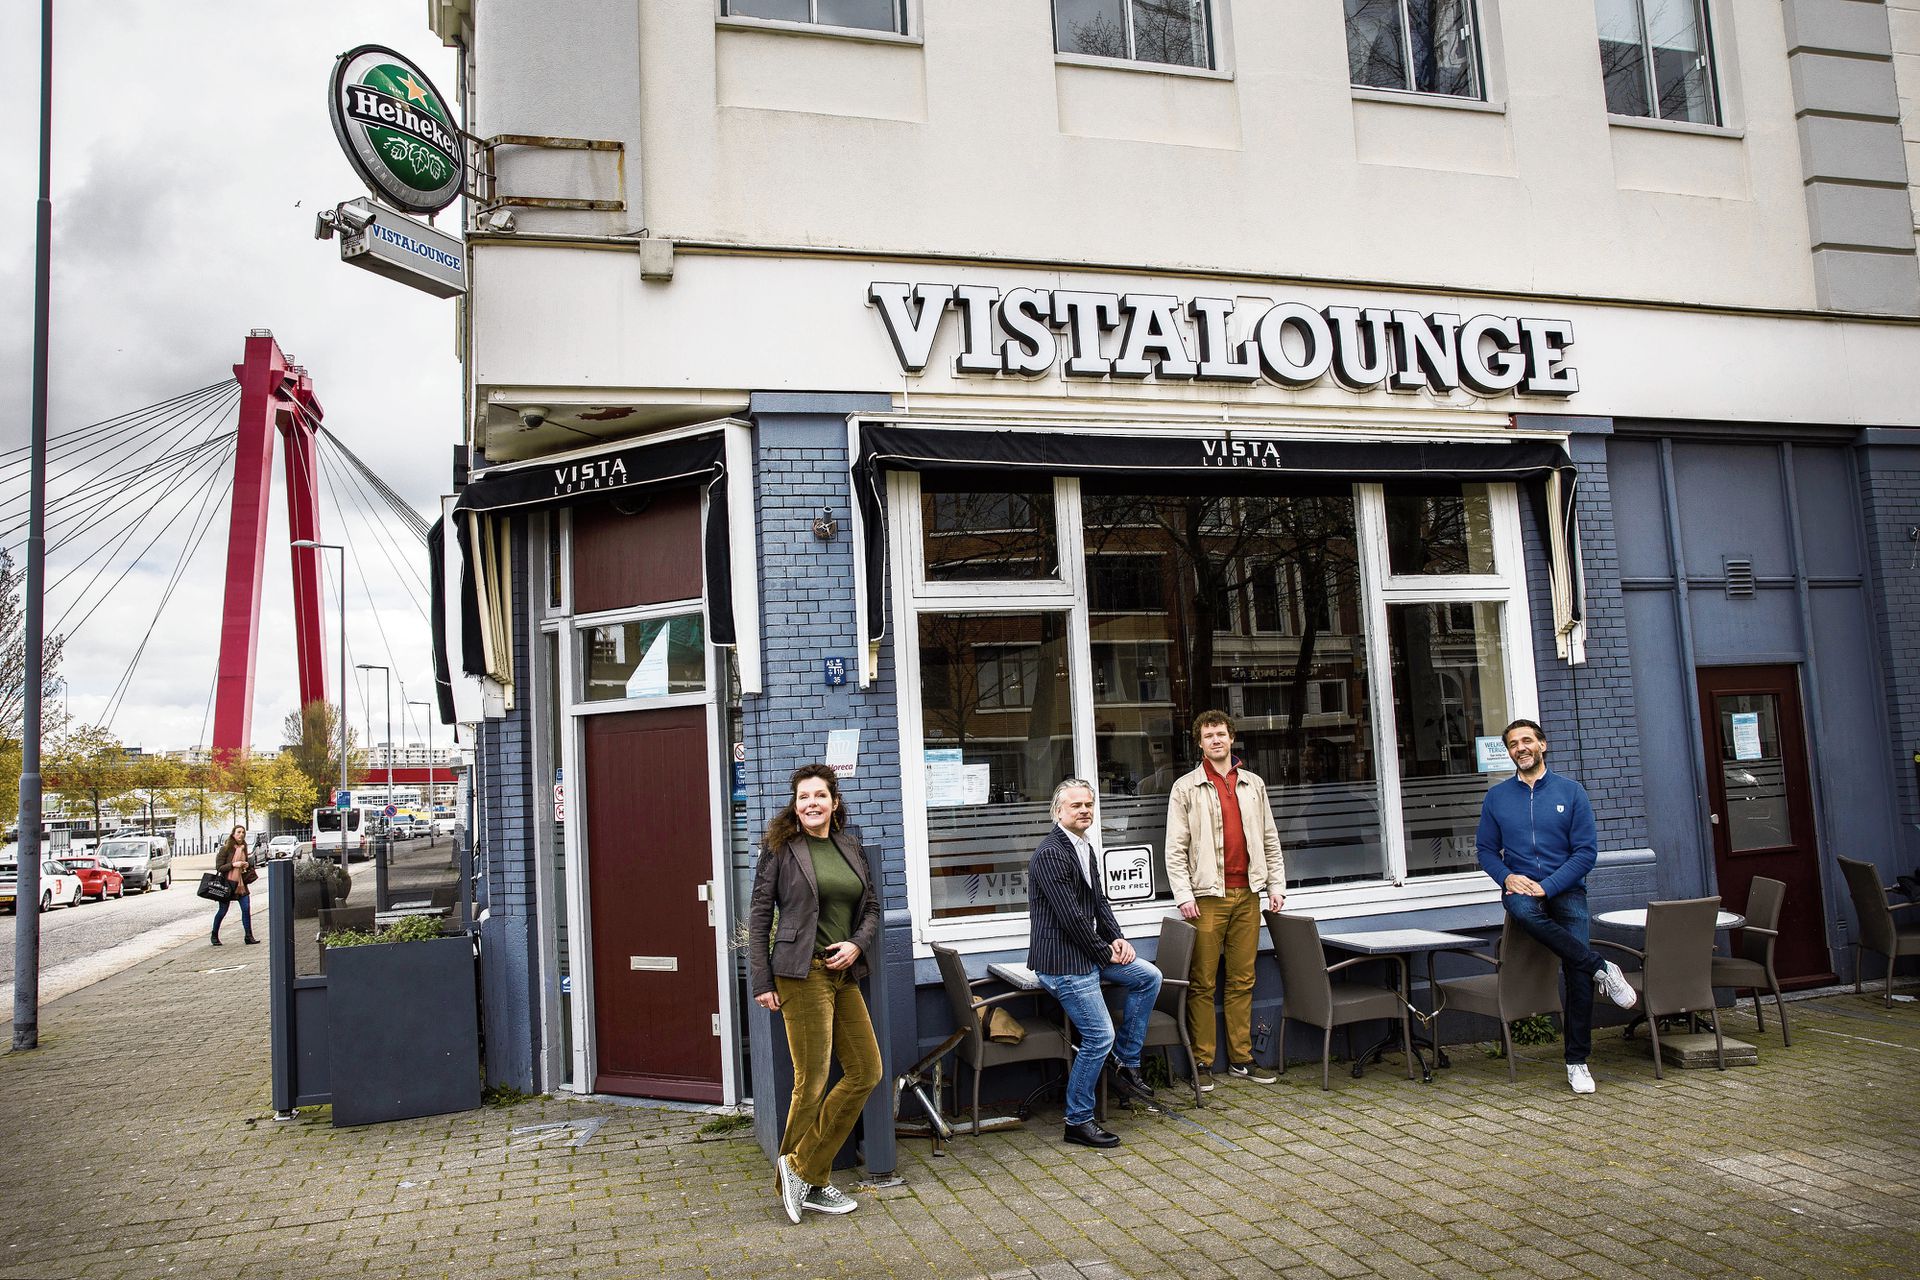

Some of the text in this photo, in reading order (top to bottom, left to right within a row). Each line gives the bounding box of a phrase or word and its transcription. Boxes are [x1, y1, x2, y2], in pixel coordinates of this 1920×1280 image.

[355, 91, 459, 162] Heineken
[371, 223, 461, 272] VISTALOUNGE
[869, 281, 1580, 397] VISTALOUNGE
[1202, 440, 1280, 458] VISTA
[1203, 457, 1281, 468] LOUNGE
[554, 458, 627, 485] VISTA
[554, 474, 627, 496] LOUNGE
[1446, 836, 1475, 849] VIS
[985, 872, 1028, 888] VIS
[1109, 867, 1143, 882] WiFi
[987, 887, 1028, 898] LOUN
[1129, 882, 1150, 890] FREE
